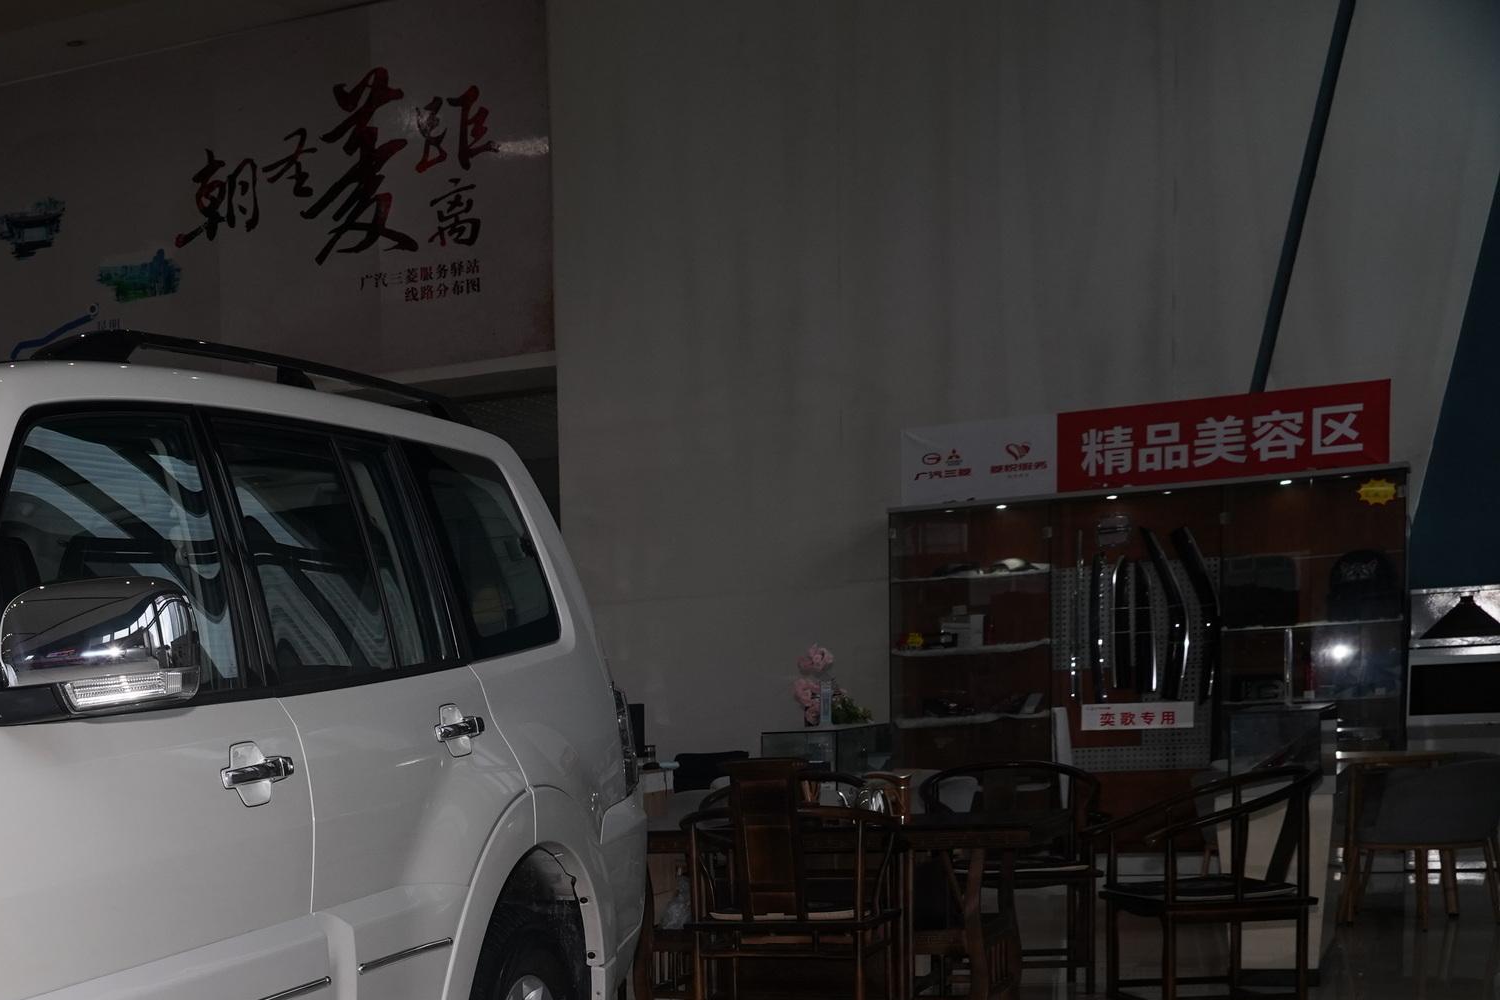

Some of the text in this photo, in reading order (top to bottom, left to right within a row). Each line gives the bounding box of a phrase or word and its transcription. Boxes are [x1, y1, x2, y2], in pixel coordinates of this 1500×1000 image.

[359, 259, 481, 291] 广汽三菱服务驿站
[404, 277, 481, 302] 线路分布图
[1080, 402, 1364, 478] 精品美容区
[1100, 711, 1176, 726] 奕歌专用
